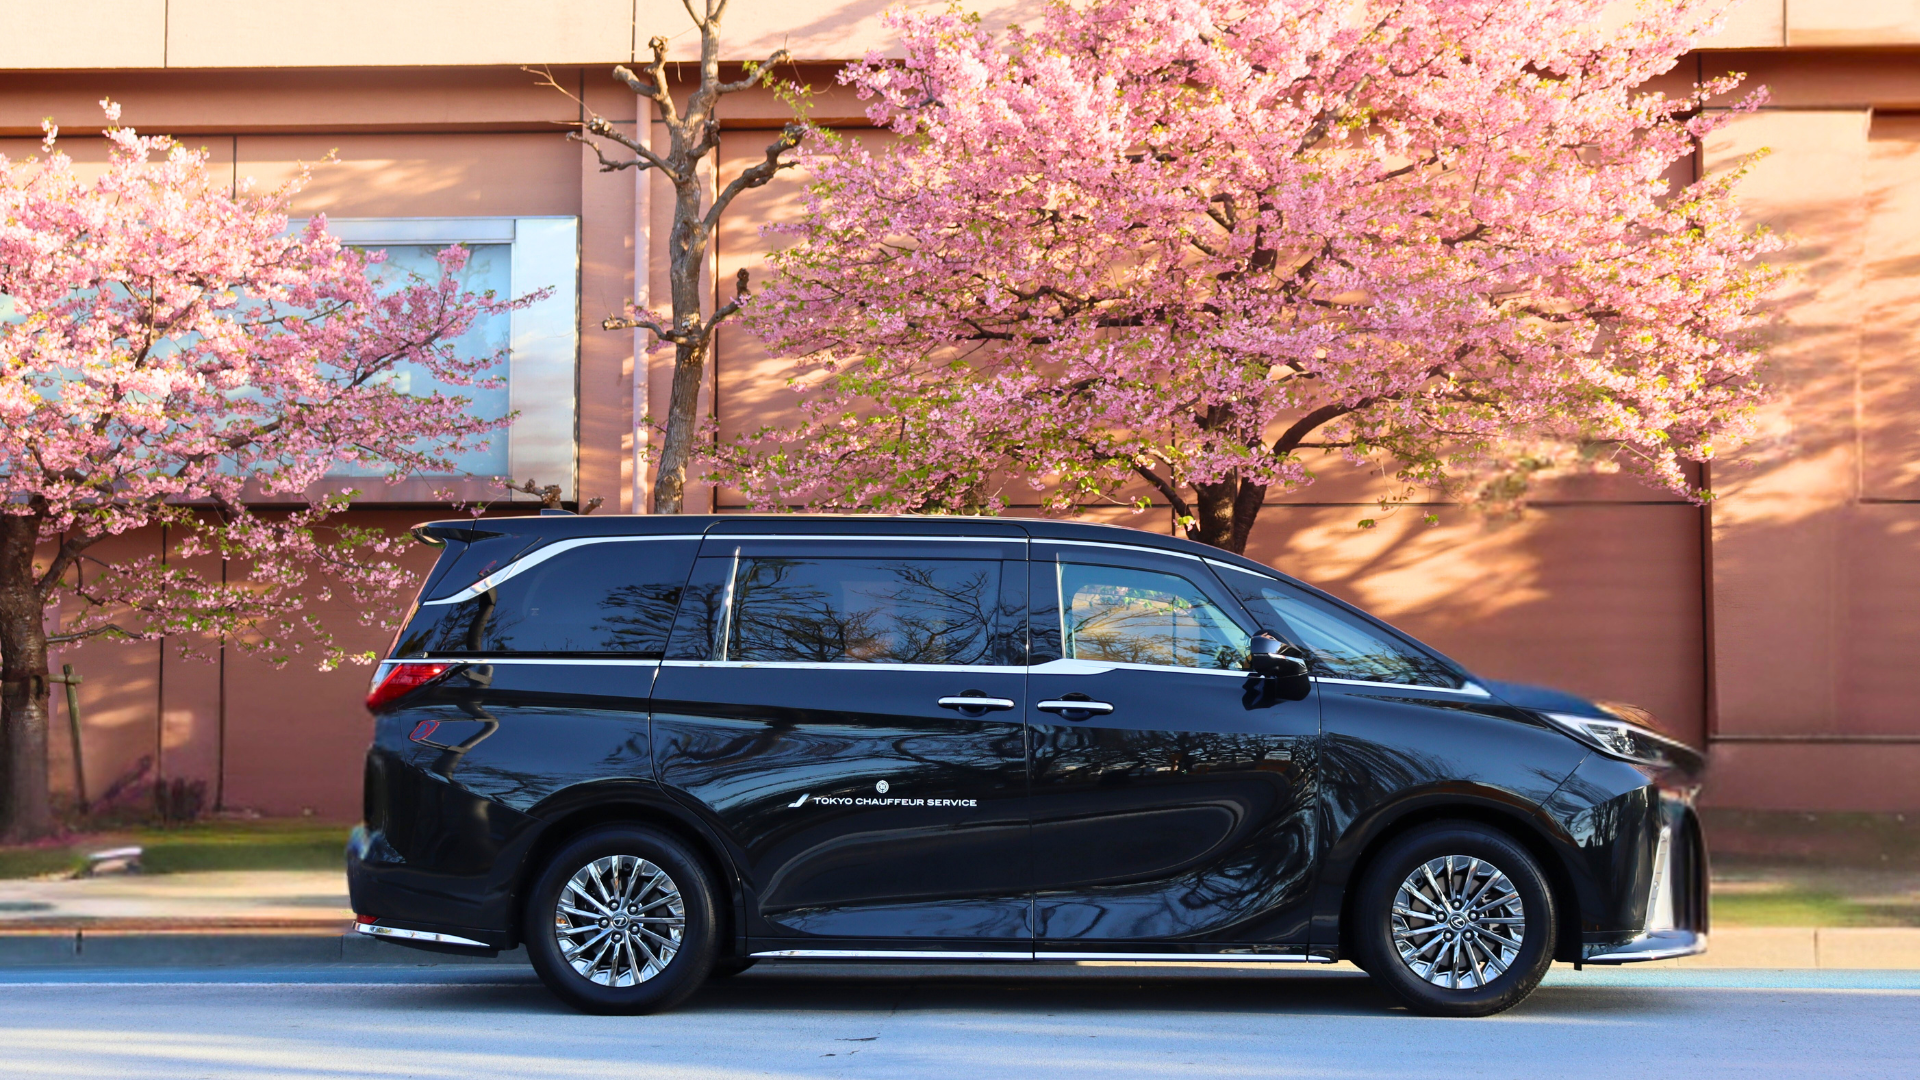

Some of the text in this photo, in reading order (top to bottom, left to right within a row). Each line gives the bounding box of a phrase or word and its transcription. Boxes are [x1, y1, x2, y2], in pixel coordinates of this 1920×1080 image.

[813, 797, 978, 807] TOKYO CHAUFFEUR SERVICE
